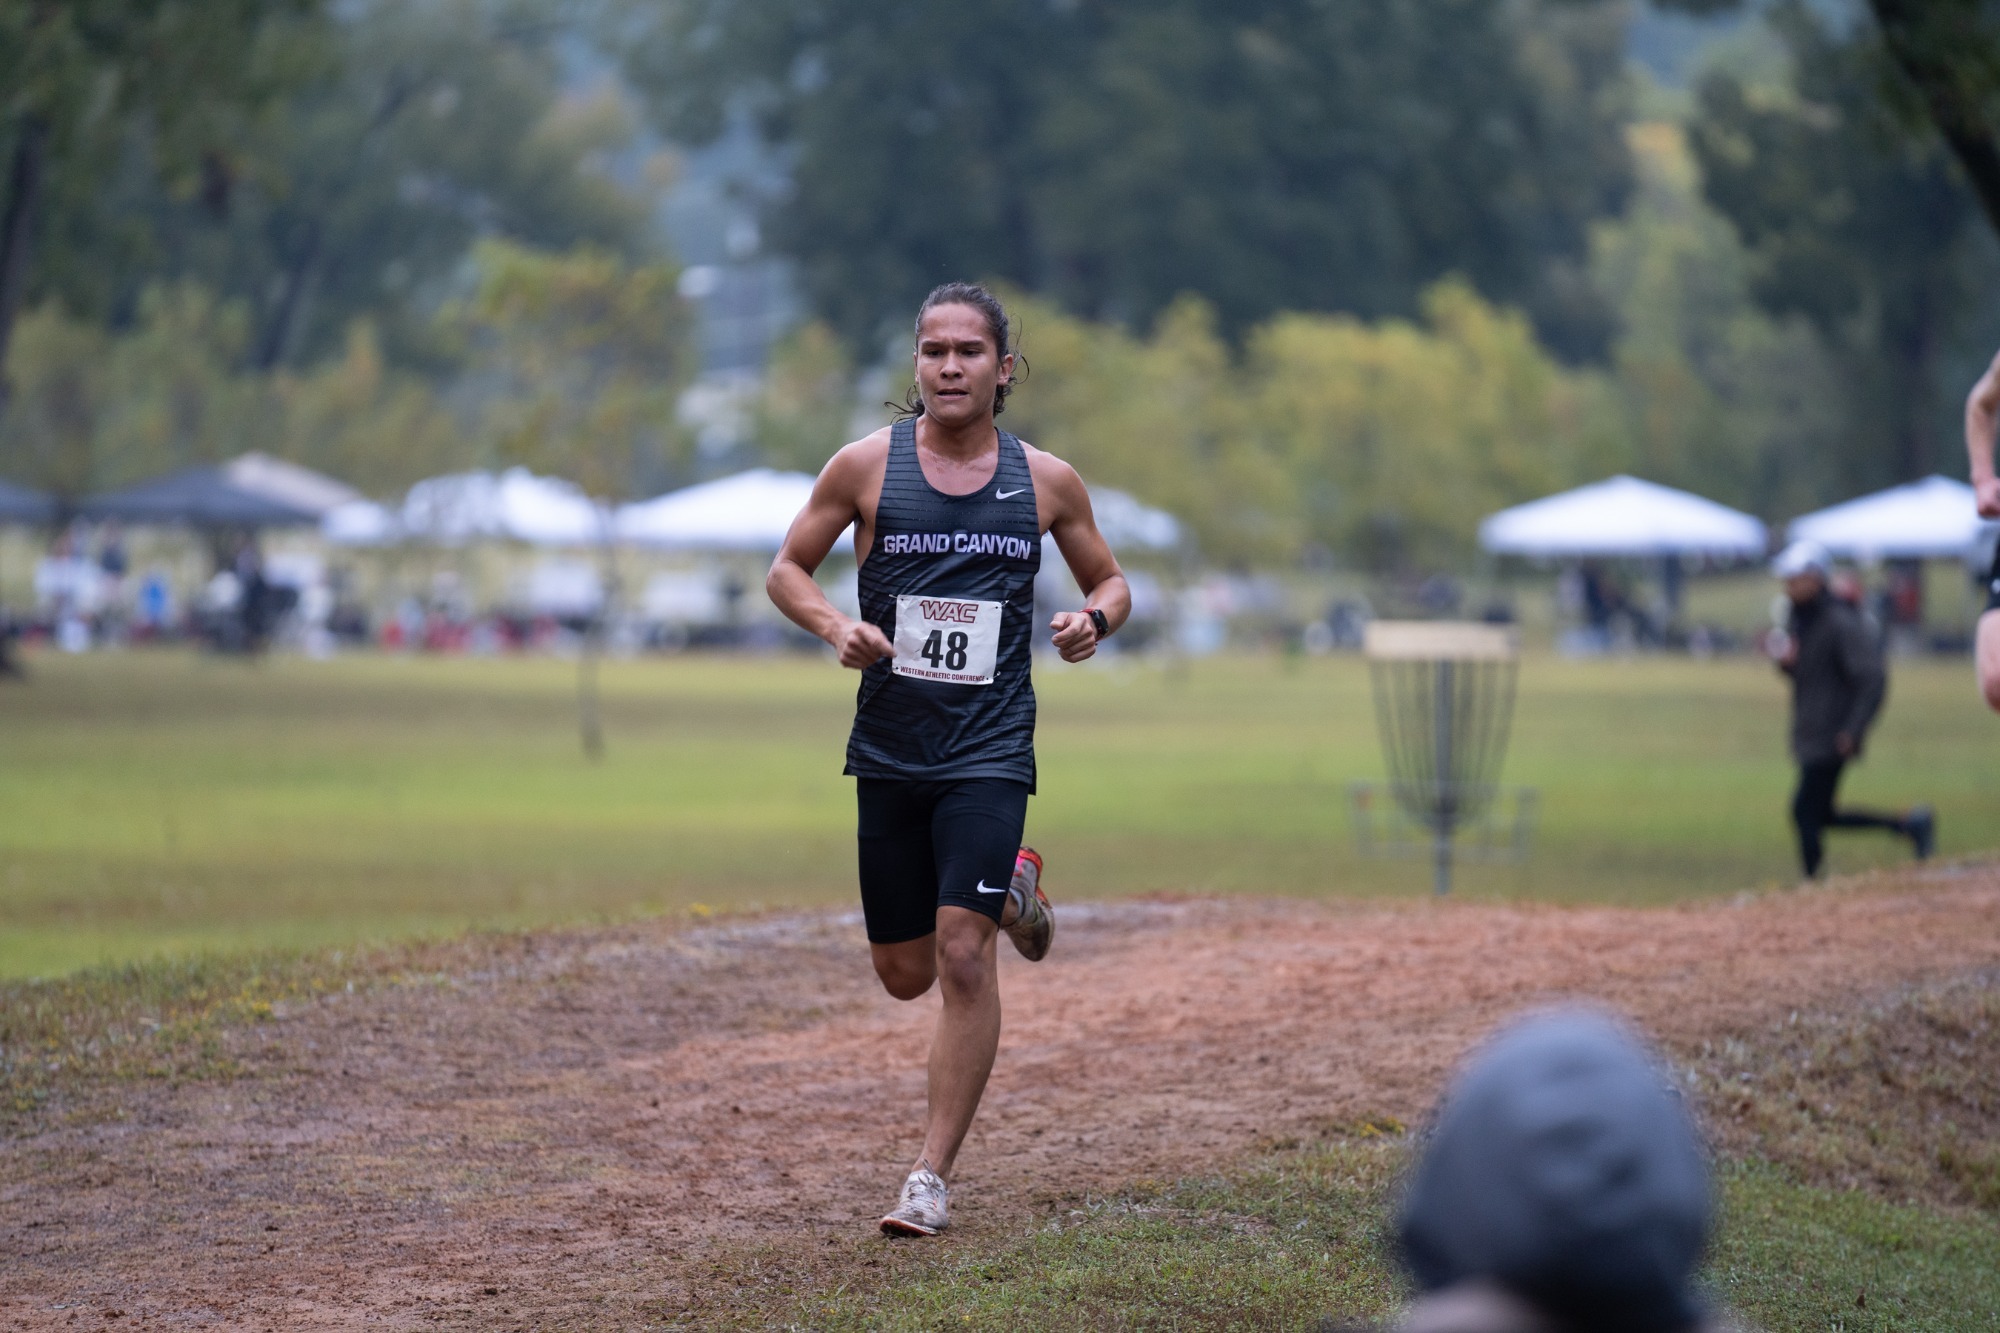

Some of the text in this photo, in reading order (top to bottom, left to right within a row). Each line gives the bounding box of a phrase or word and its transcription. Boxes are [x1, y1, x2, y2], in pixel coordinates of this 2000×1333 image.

[884, 533, 1031, 560] GRAND CANYON
[920, 600, 979, 623] WAC
[921, 629, 969, 671] 48
[900, 666, 985, 682] WESTERN ATHLETIC CONFERENCE
